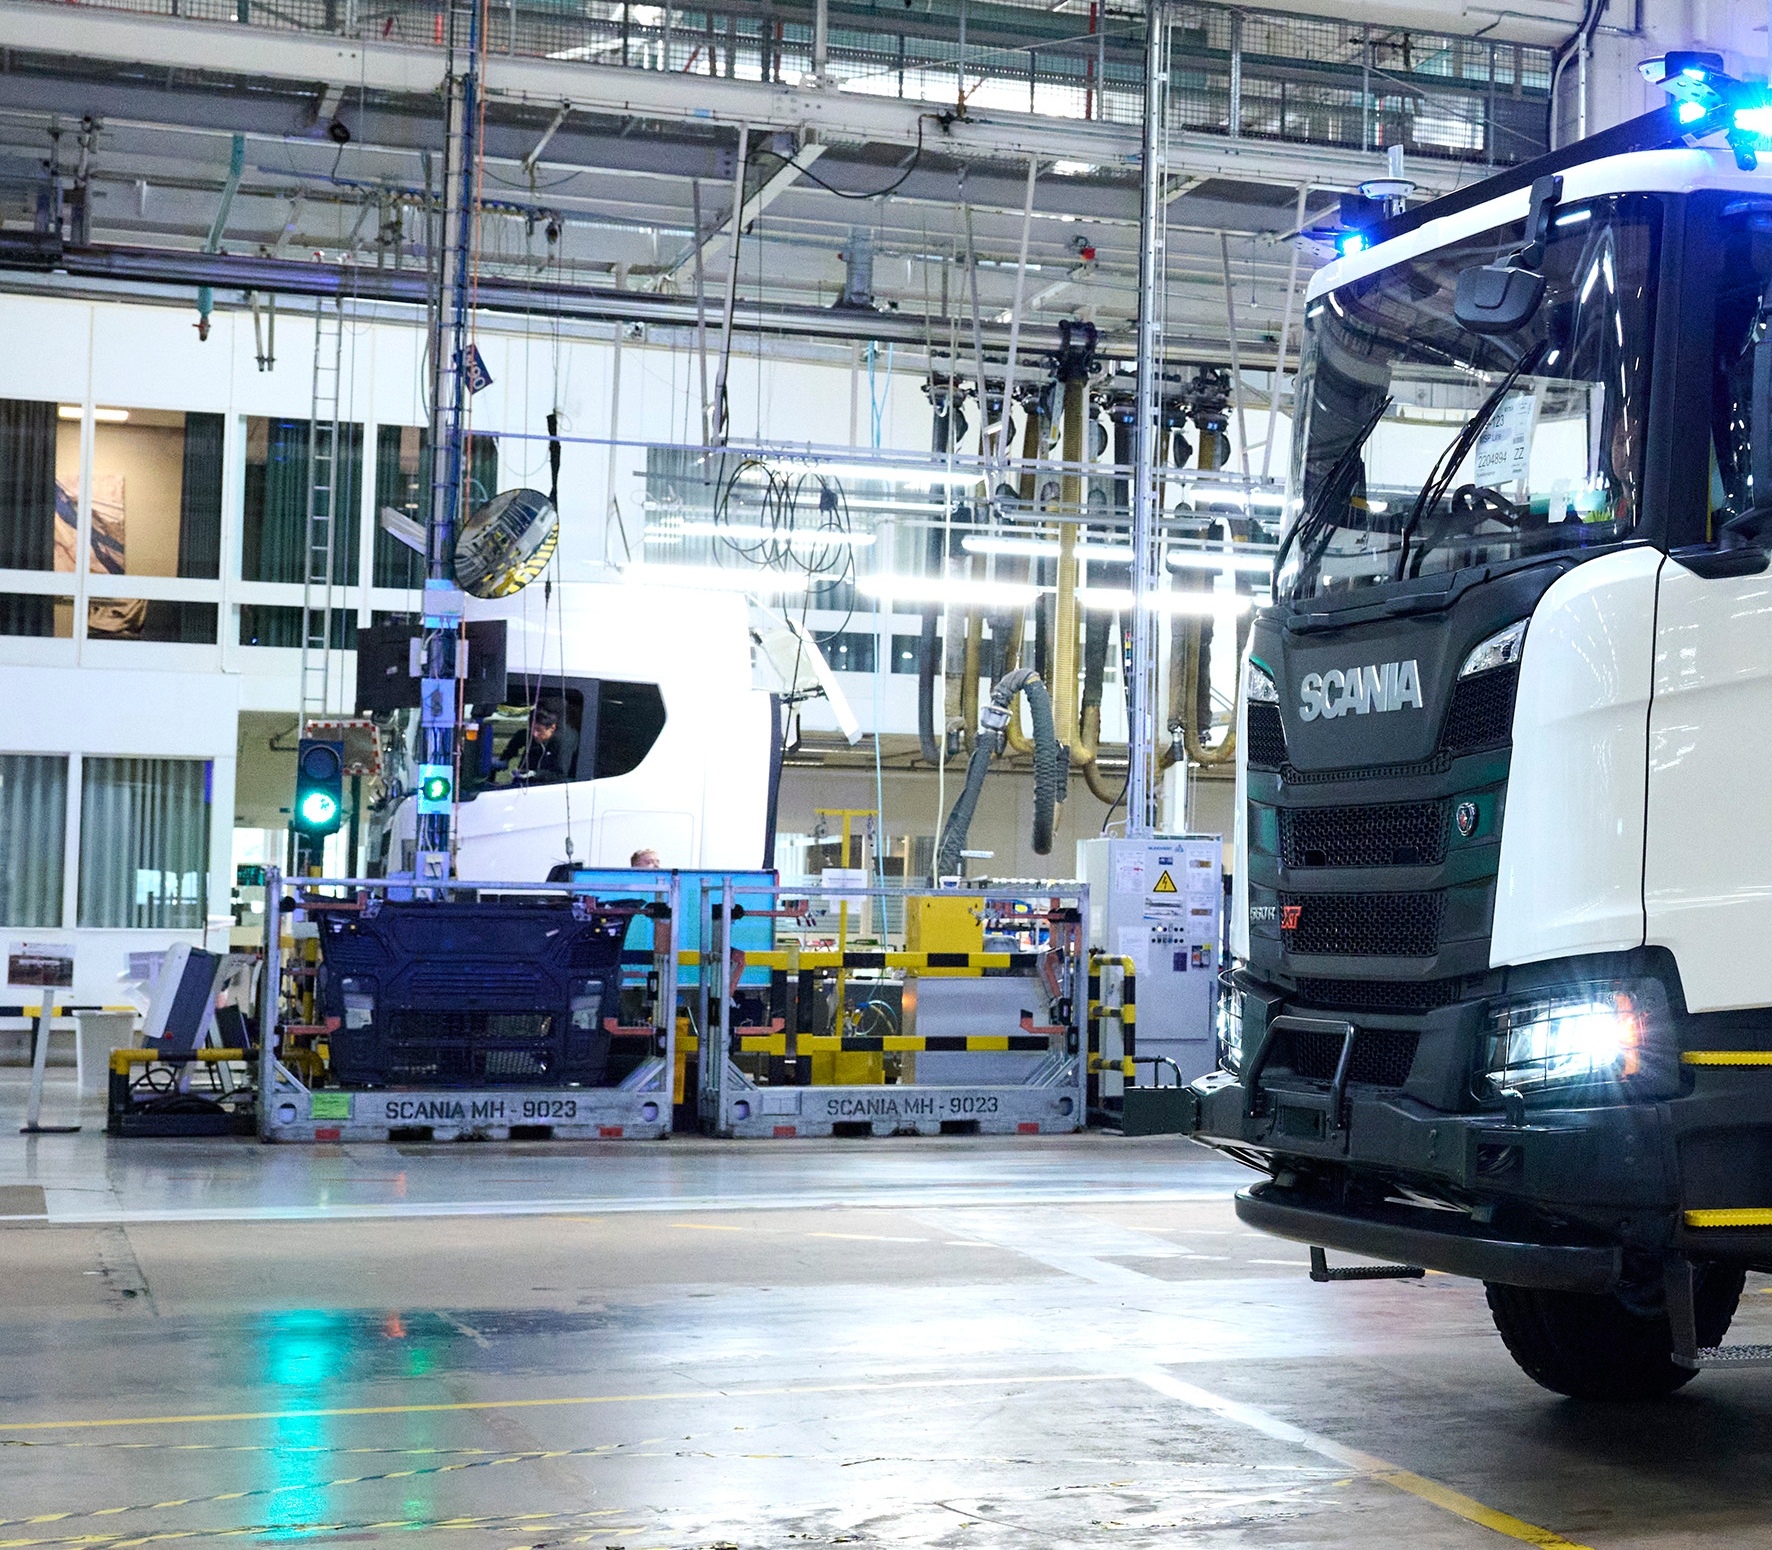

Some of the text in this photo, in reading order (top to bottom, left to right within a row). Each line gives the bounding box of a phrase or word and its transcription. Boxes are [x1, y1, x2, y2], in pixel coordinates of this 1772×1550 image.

[1299, 659, 1423, 721] SCANIA
[1281, 905, 1302, 929] XT
[385, 1100, 465, 1119] SCANIA
[471, 1100, 505, 1118] MH
[522, 1099, 577, 1118] 9023
[827, 1099, 898, 1116] SCANIA
[904, 1097, 934, 1115] MH
[950, 1096, 998, 1114] 9023
